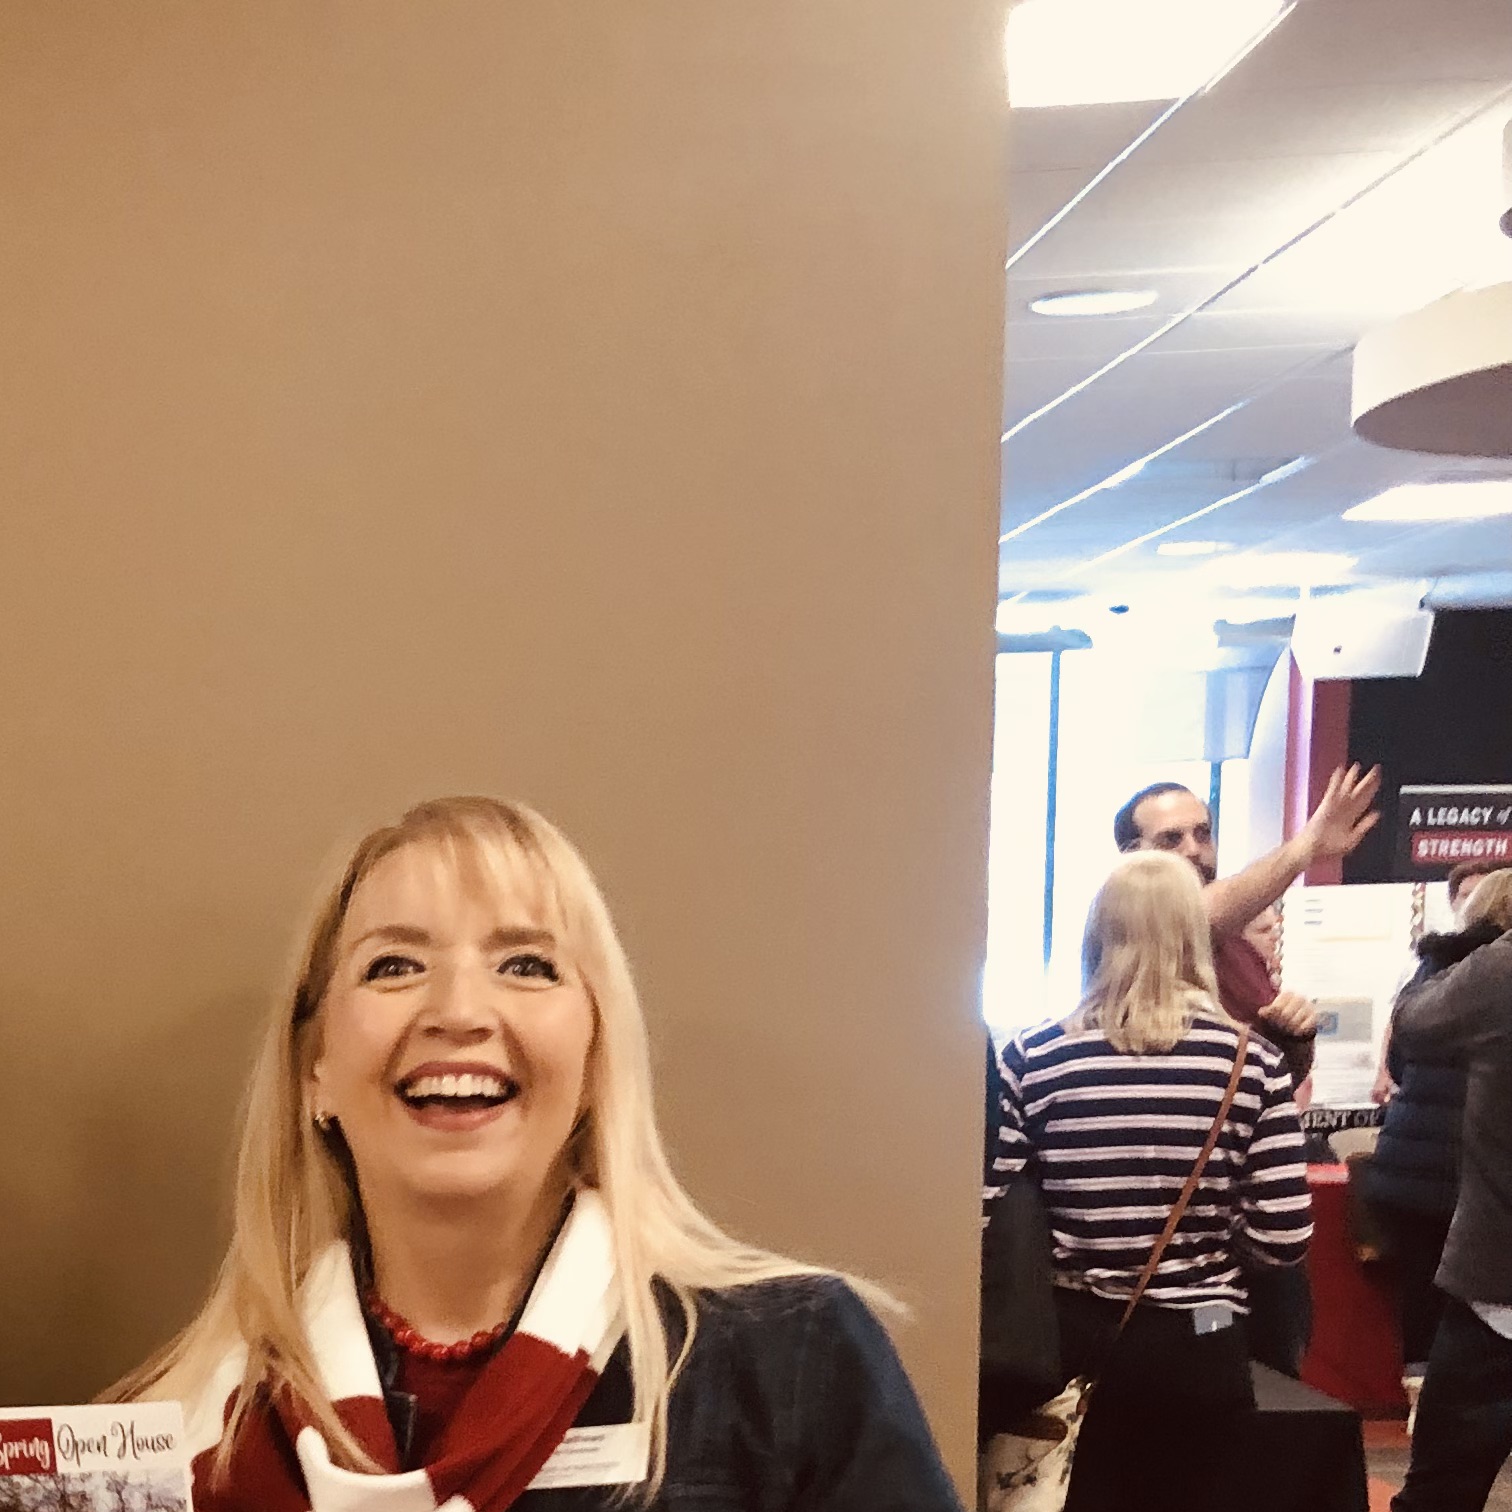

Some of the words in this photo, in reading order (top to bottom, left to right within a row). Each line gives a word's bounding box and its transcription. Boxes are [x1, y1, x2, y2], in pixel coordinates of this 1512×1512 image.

[1409, 806, 1422, 826] A
[1427, 806, 1494, 826] LEGACY
[1416, 838, 1508, 858] STRENGTH
[56, 1423, 109, 1468] Open
[110, 1419, 175, 1461] House
